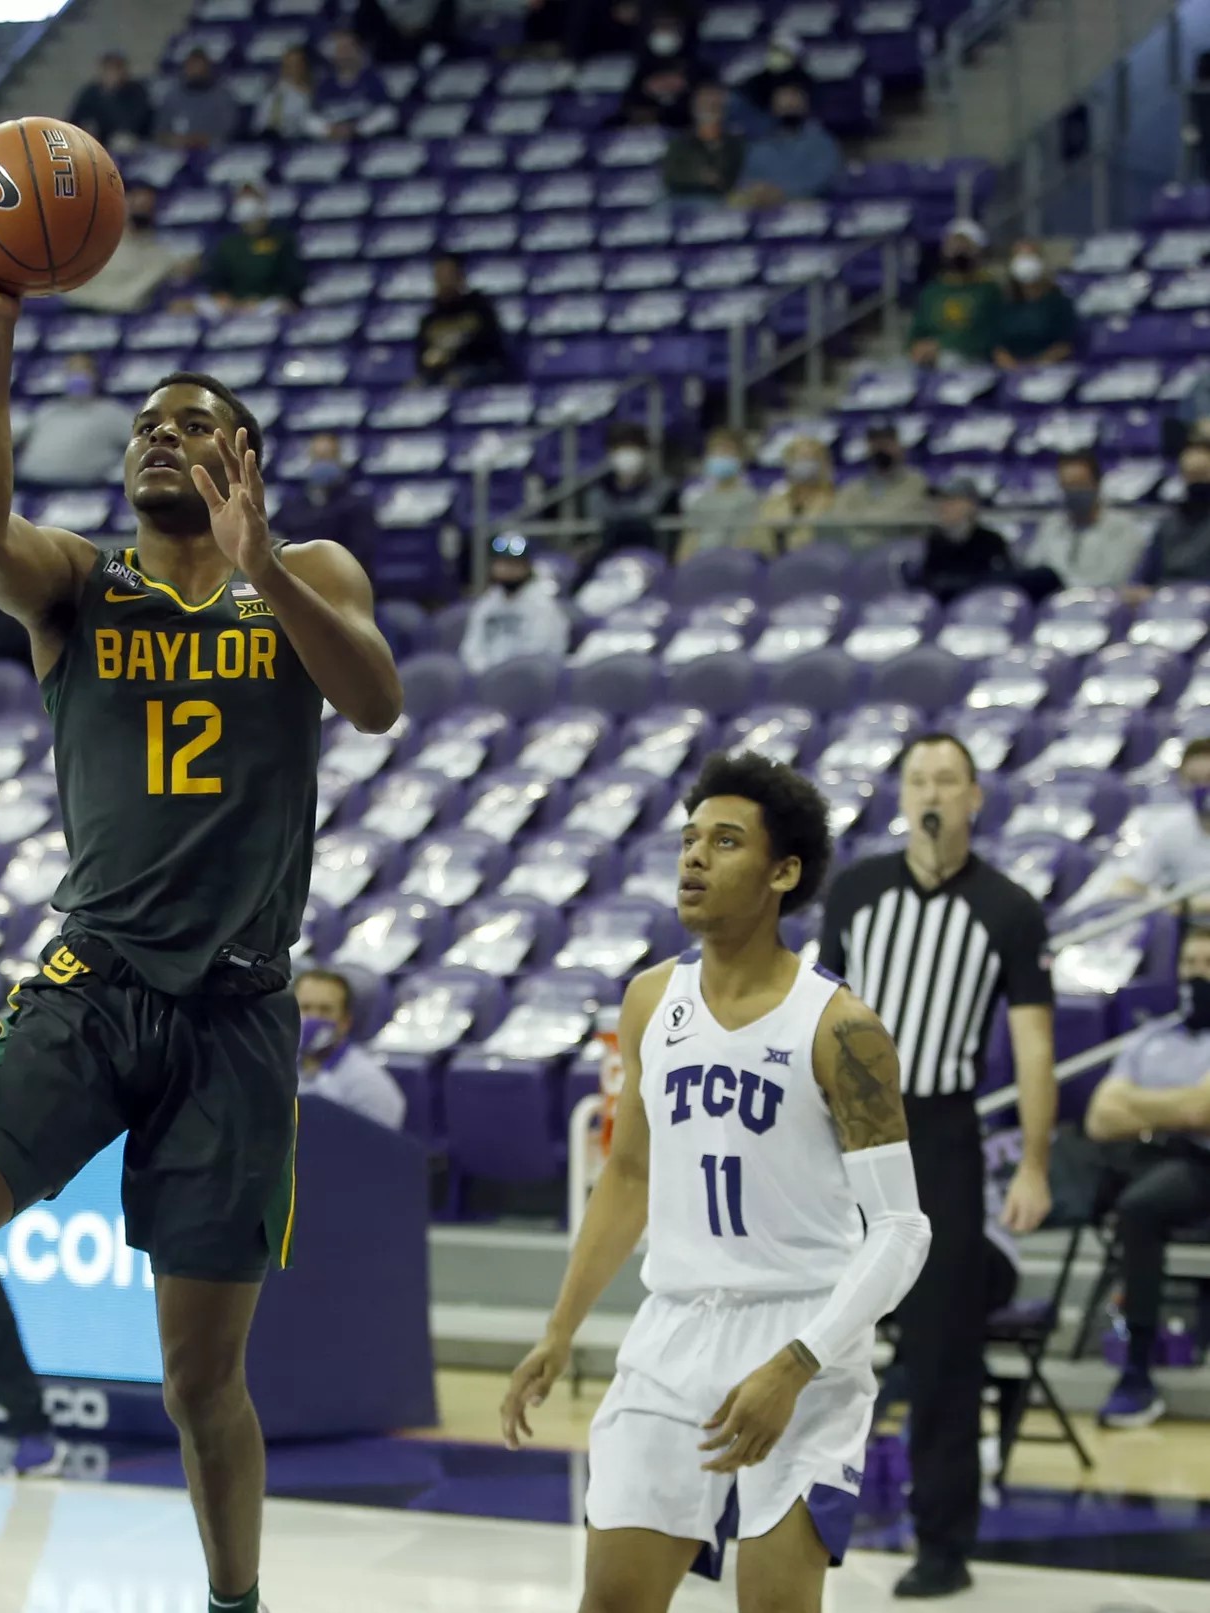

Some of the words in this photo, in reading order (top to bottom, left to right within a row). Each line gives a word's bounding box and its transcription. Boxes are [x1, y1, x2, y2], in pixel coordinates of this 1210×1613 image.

[95, 628, 277, 682] BAYLOR
[146, 700, 222, 795] 12
[665, 1064, 785, 1136] TCU
[700, 1154, 750, 1238] 11
